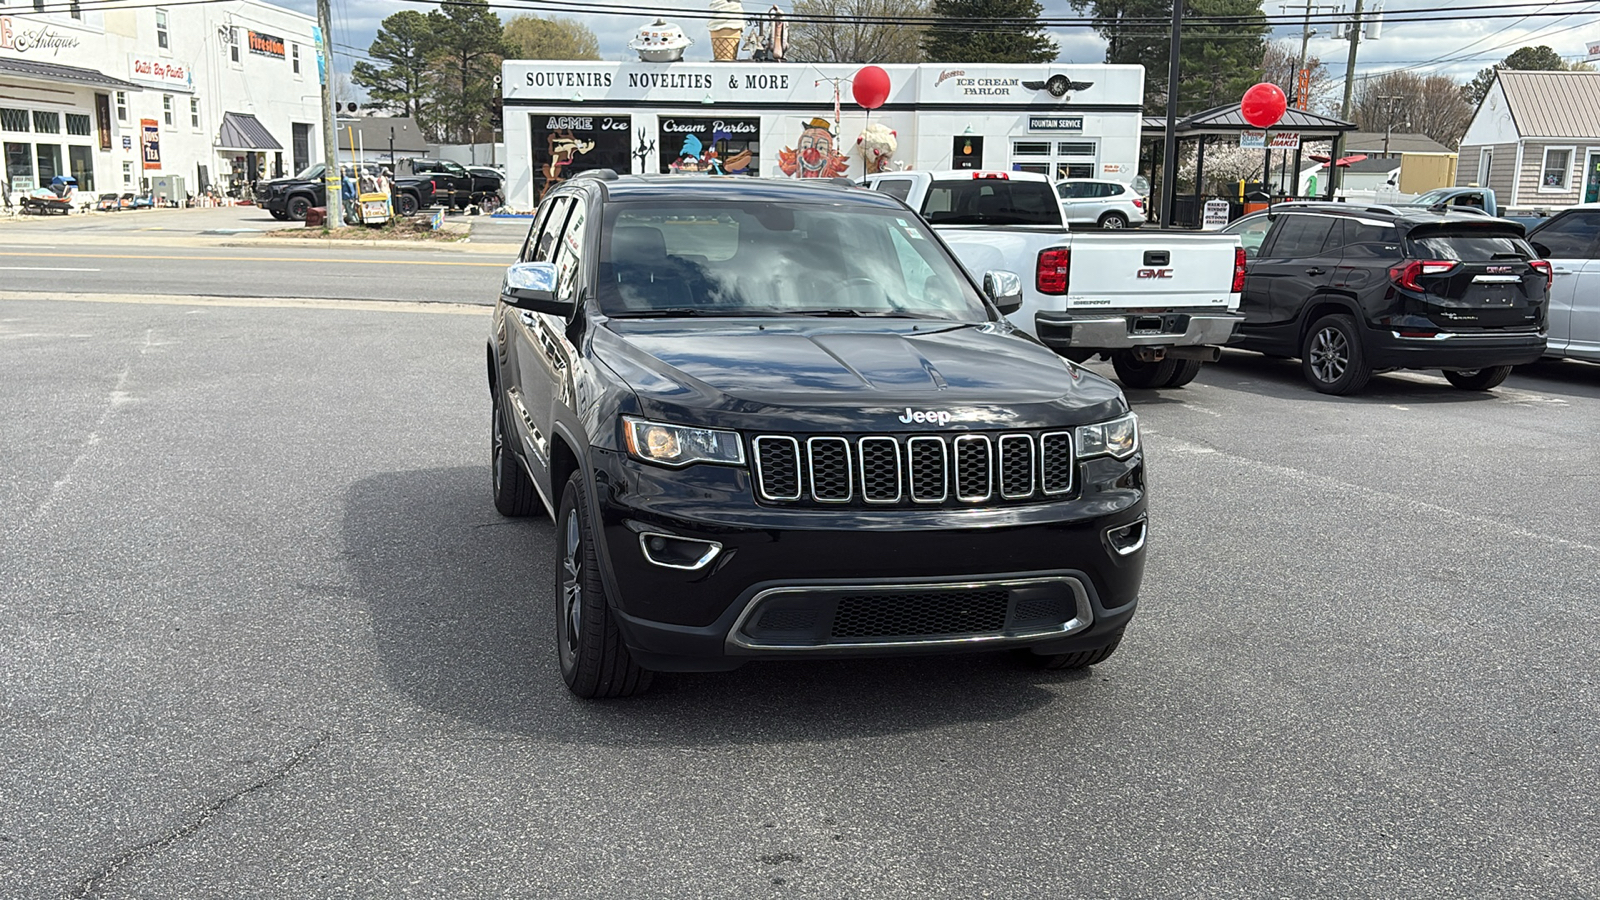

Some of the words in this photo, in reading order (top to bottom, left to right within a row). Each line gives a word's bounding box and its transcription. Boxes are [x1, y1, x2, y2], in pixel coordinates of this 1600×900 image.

[15, 25, 80, 57] Antiques
[248, 31, 285, 55] Firestone
[135, 60, 151, 74] Dutch
[154, 63, 165, 79] Boy
[166, 65, 184, 79] Paints
[526, 72, 612, 87] SOUVENIRS
[629, 73, 712, 88] NOVELTIES
[728, 75, 739, 89] &
[745, 75, 789, 89] MORE
[956, 78, 975, 86] ICE
[977, 78, 1019, 86] CREAM
[546, 117, 593, 130] ACME
[601, 118, 629, 130] Ice
[663, 119, 706, 132] Cream
[712, 120, 757, 133] Parlor
[1031, 119, 1058, 128] FOUNTAIN
[1058, 119, 1081, 128] SERVICE
[146, 147, 159, 160] TEA
[1137, 269, 1173, 278] GMC
[899, 407, 951, 427] Jeep
